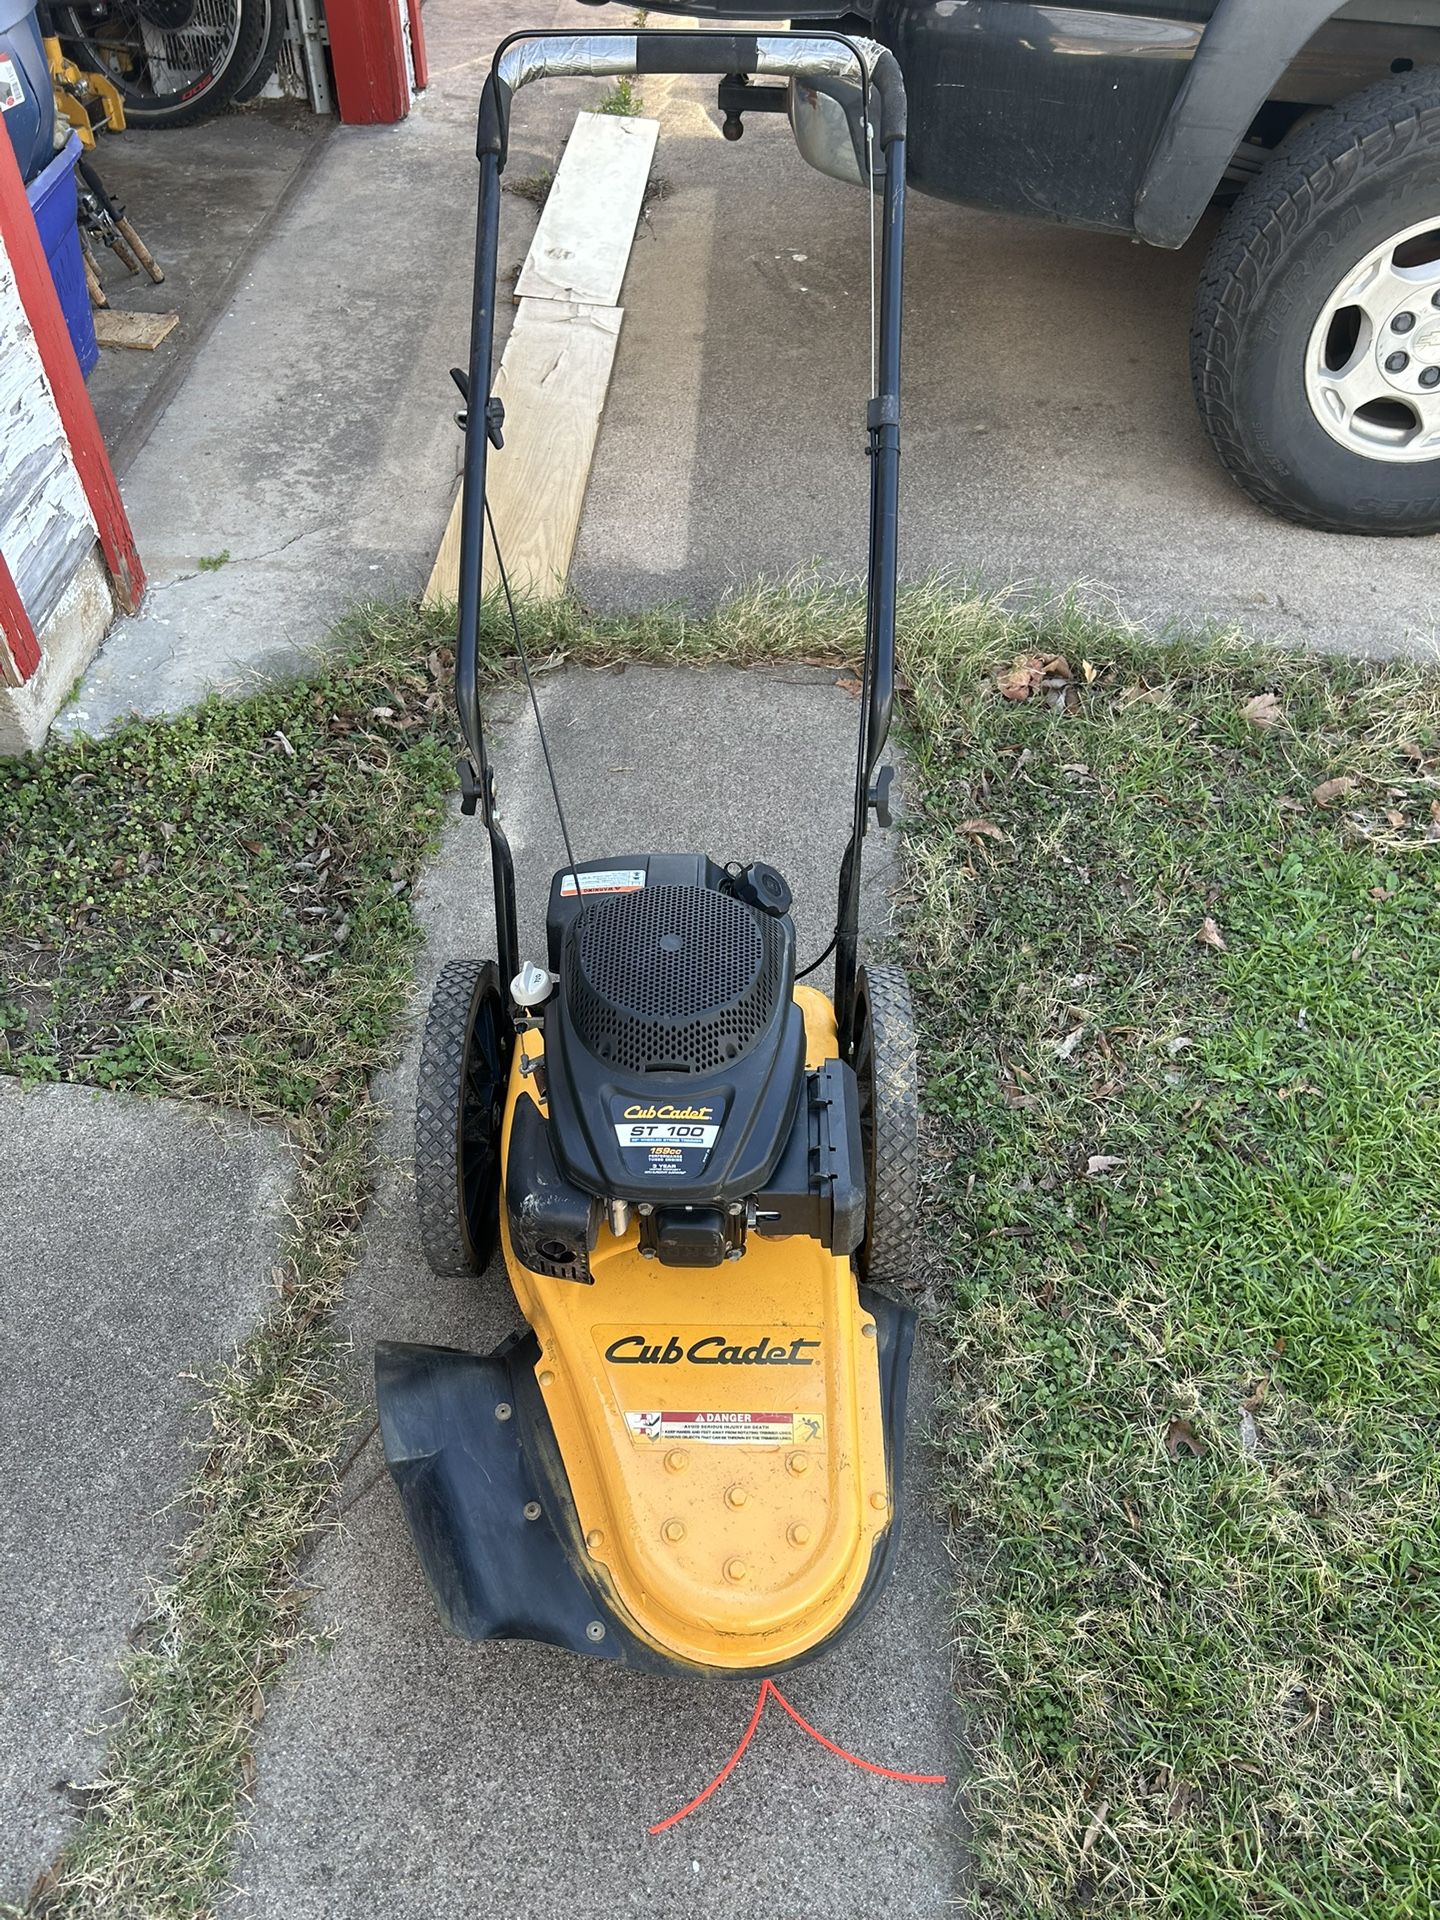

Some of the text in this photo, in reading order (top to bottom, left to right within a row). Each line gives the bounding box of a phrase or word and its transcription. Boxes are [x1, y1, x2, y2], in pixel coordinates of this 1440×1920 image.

[623, 1105, 713, 1120] Cub Cadet
[630, 1126, 705, 1137] ST 100
[605, 1336, 821, 1365] Cub Cadet
[706, 1413, 752, 1422] DANGER
